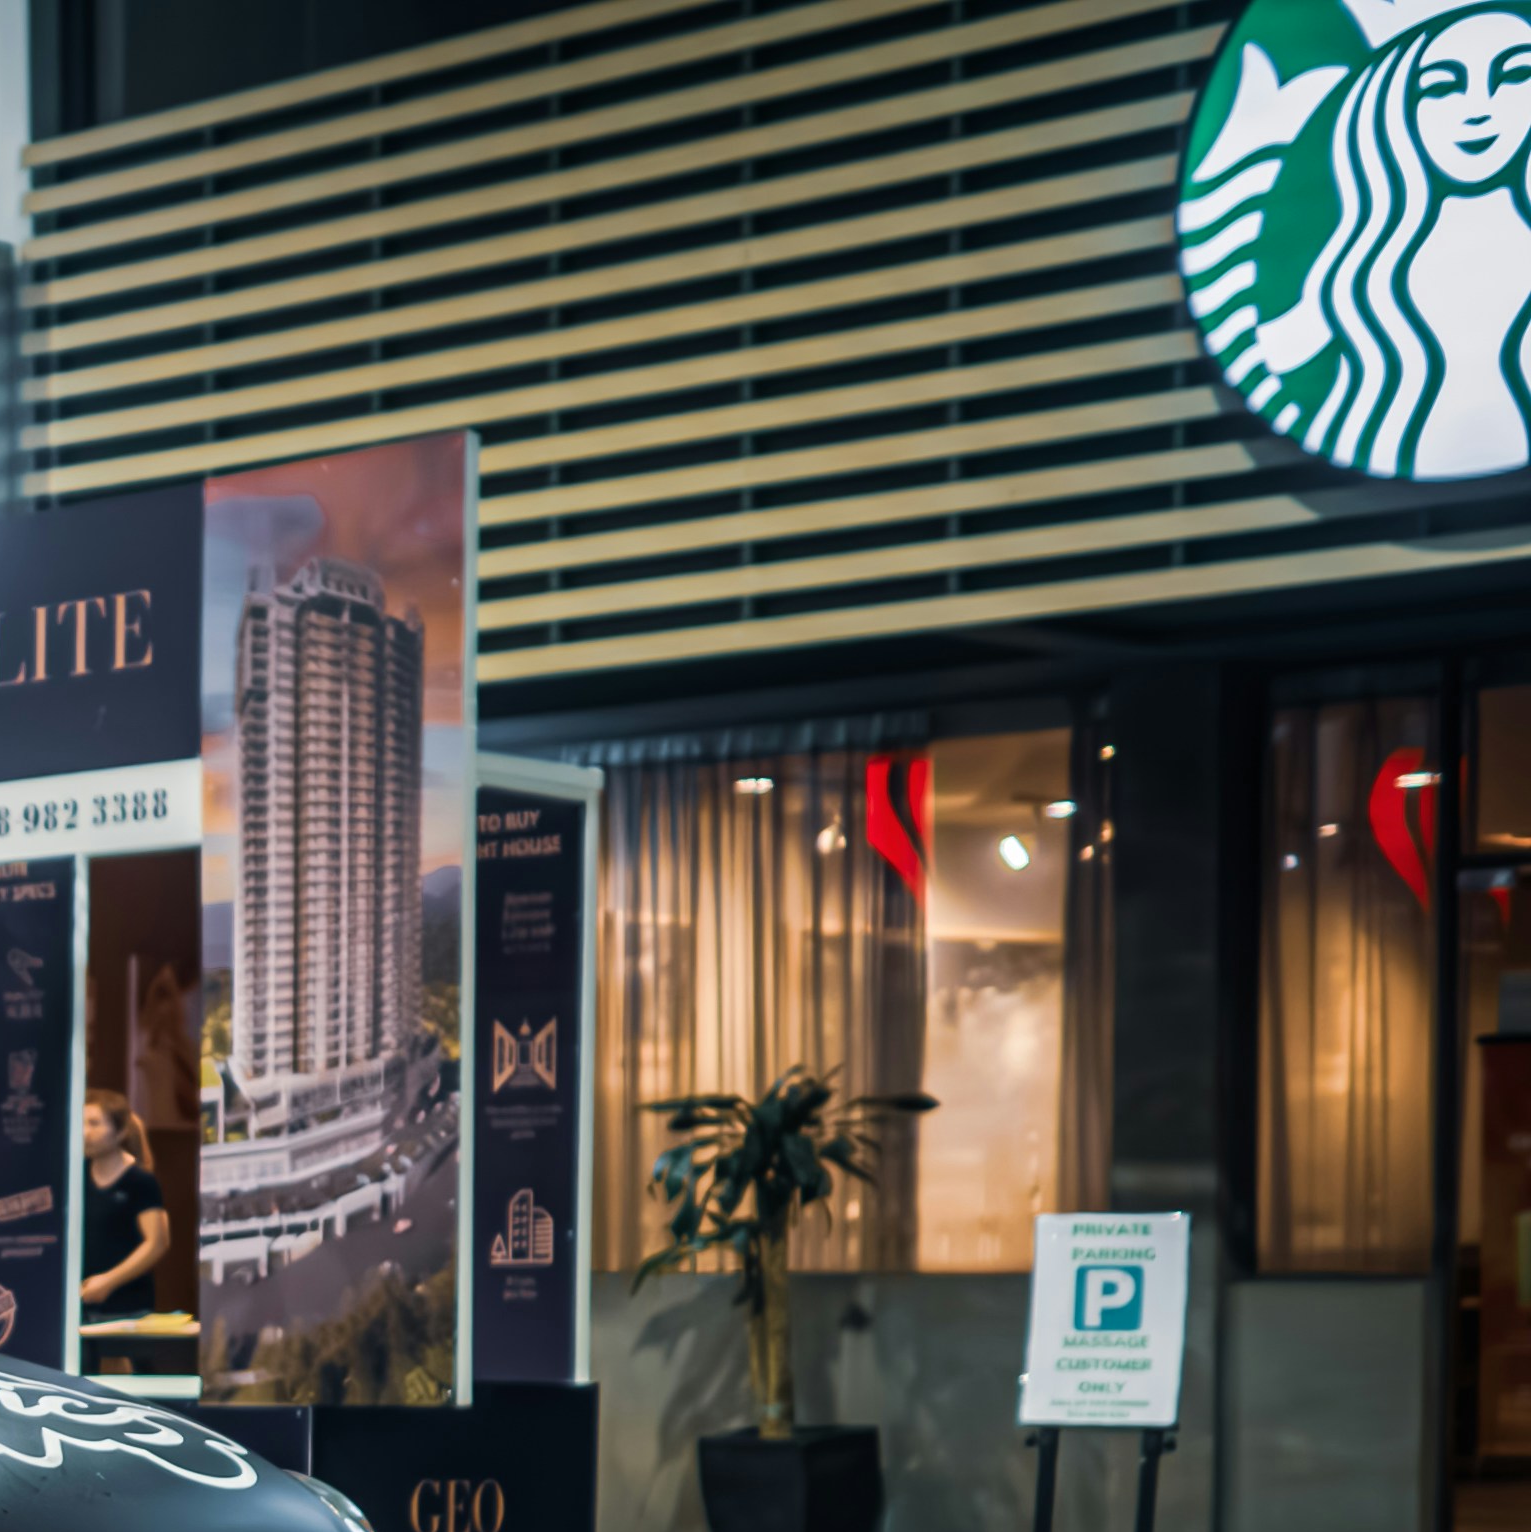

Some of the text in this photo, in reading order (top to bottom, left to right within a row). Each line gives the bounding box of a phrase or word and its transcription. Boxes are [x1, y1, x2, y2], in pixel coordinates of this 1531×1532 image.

[92, 788, 169, 827] 3388
[1071, 1222, 1152, 1237] PRIVATE
[1071, 1247, 1155, 1261] PARKING
[1062, 1335, 1150, 1349] MASSAGE
[1055, 1356, 1152, 1372] CUSTOMER
[1077, 1380, 1126, 1394] ONLY
